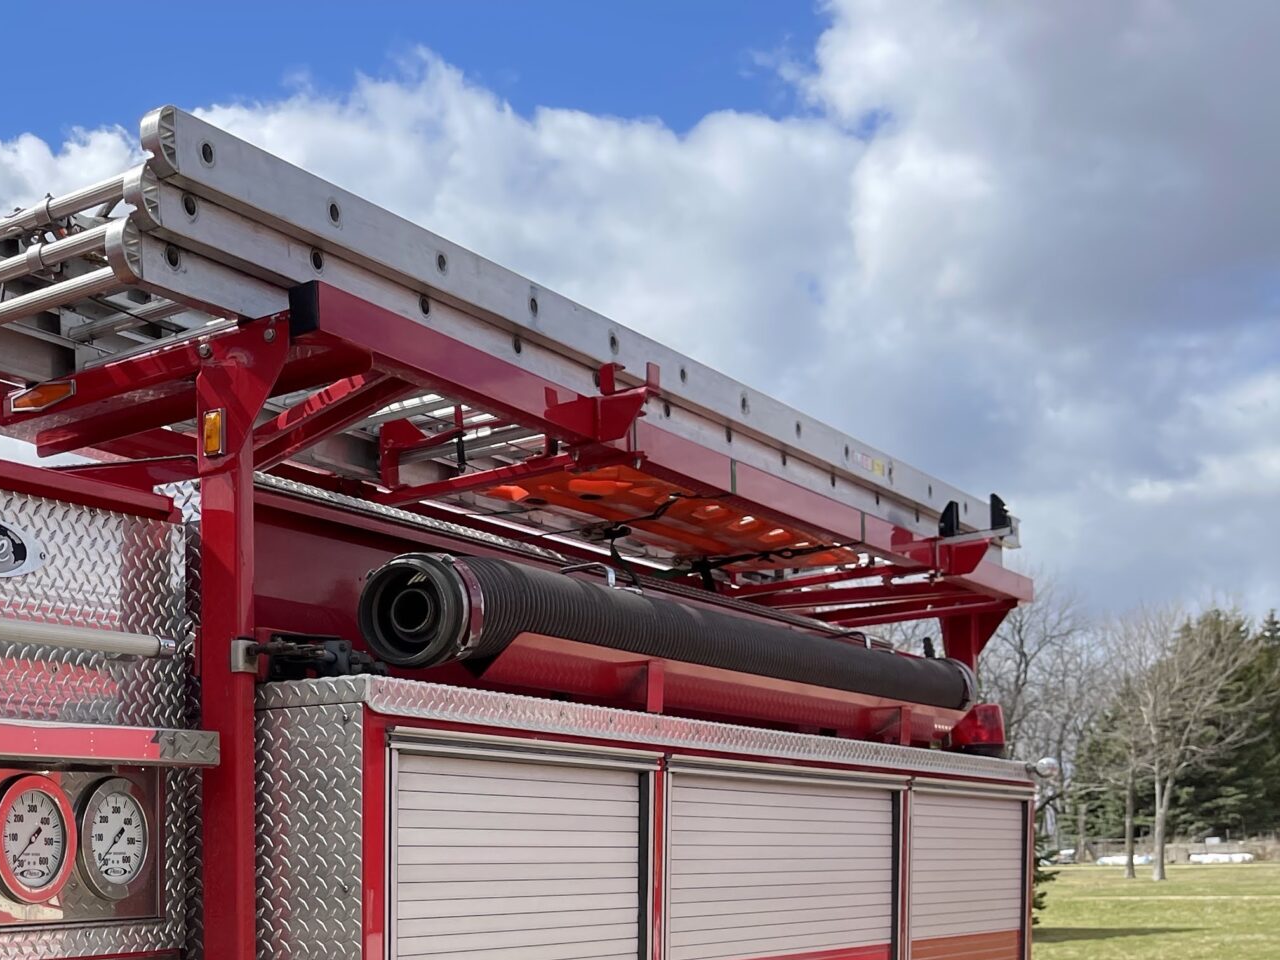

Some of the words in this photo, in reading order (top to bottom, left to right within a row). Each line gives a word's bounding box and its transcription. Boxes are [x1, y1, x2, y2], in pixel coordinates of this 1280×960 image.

[27, 804, 38, 813] 300
[111, 805, 121, 814] 300
[13, 814, 24, 823] 200
[40, 816, 51, 825] 400
[99, 815, 109, 824] 200
[123, 817, 133, 826] 400
[8, 832, 18, 842] 100
[44, 837, 54, 846] 500
[94, 833, 104, 842] 100
[126, 837, 136, 845] 500
[39, 856, 49, 865] 600
[121, 855, 131, 864] 600
